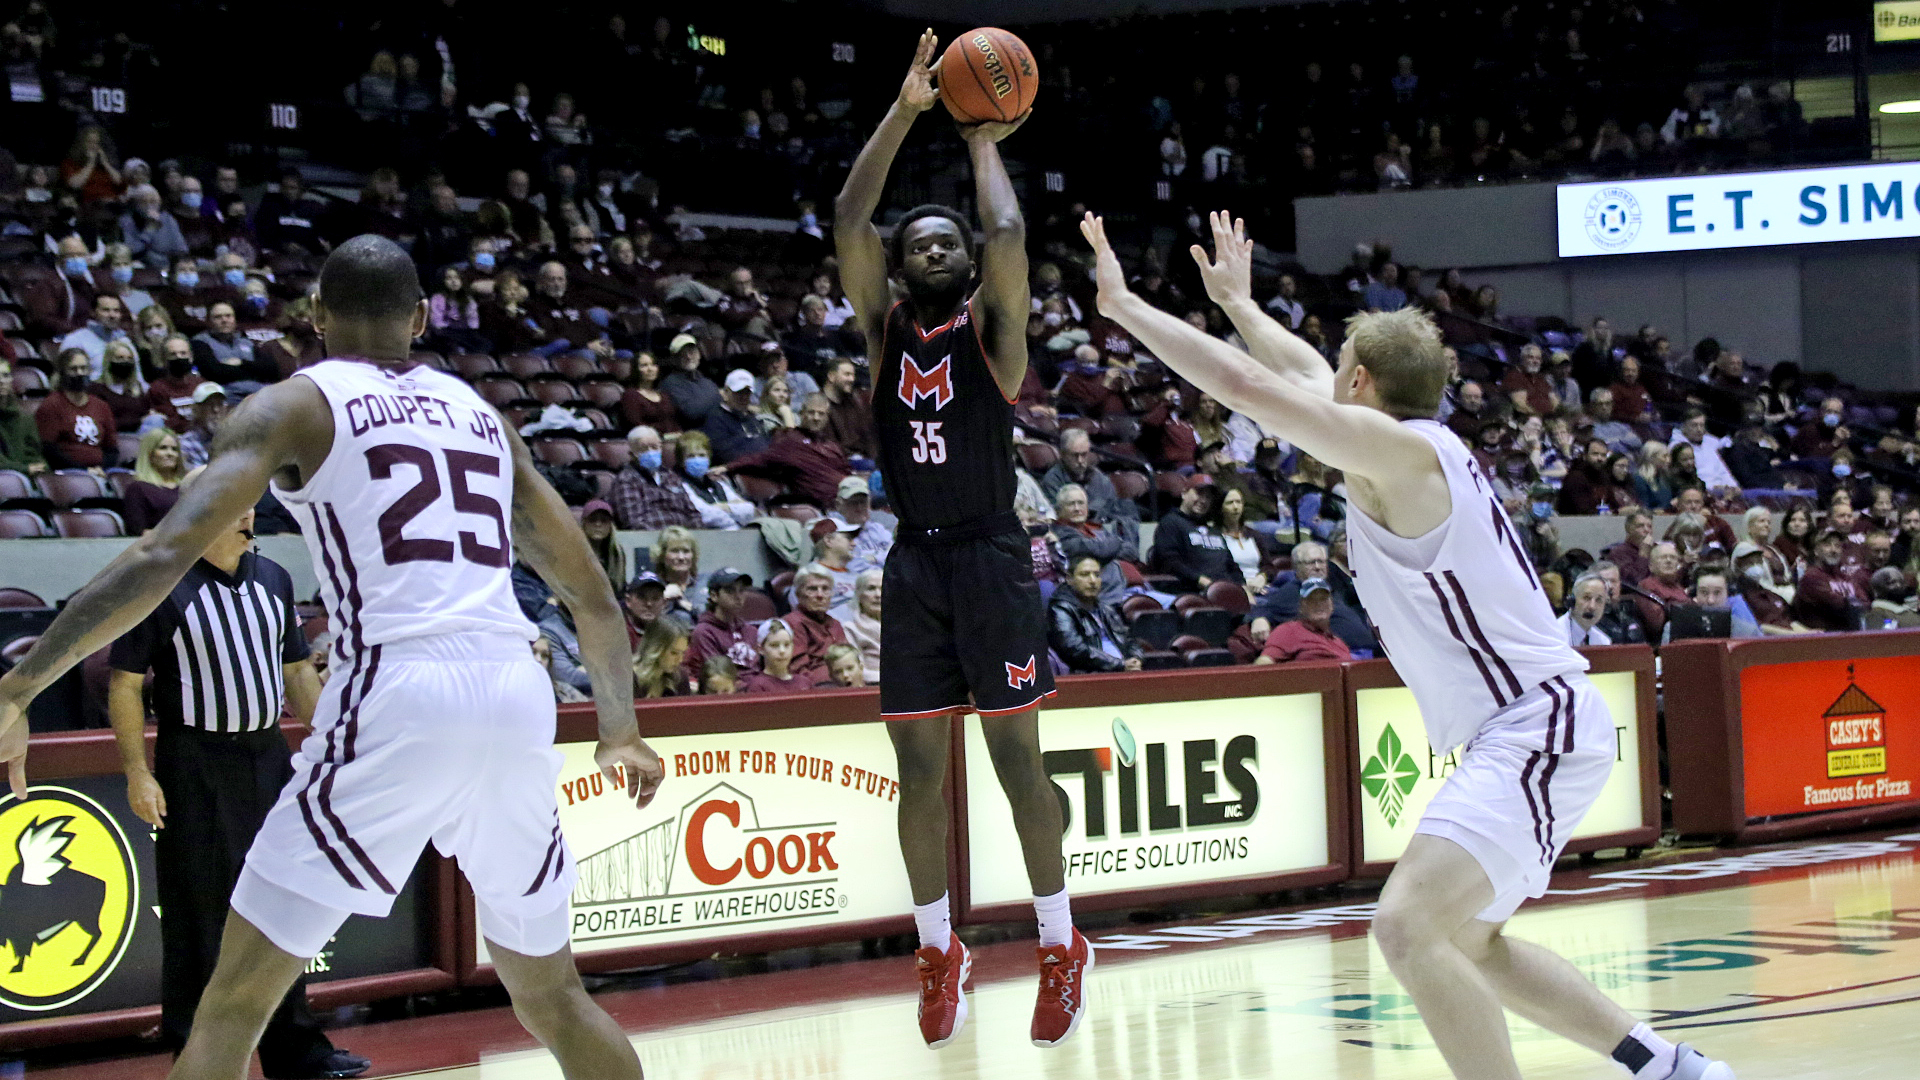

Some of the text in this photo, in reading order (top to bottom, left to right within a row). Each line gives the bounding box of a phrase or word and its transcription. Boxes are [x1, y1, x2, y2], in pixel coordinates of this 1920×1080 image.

[832, 42, 855, 63] 210
[1826, 33, 1851, 53] 211
[972, 34, 1013, 99] Wilson
[92, 87, 126, 113] 109
[271, 103, 297, 129] 110
[1046, 172, 1064, 192] 110
[1667, 180, 1920, 235] E.T. SIM
[898, 351, 954, 412] M
[344, 393, 505, 453] COUPET JR
[908, 420, 947, 464] 35
[363, 443, 511, 570] 25
[1830, 717, 1881, 745] CASEY'S
[561, 750, 900, 806] YOU ND ROOM FOR YOUR STUFF
[1803, 777, 1910, 805] Famous for Pizza
[1224, 804, 1244, 818] INC.
[1062, 836, 1249, 877] FFICE SOLUTIONS
[572, 887, 836, 934] PORTABLE WAREHOUSES
